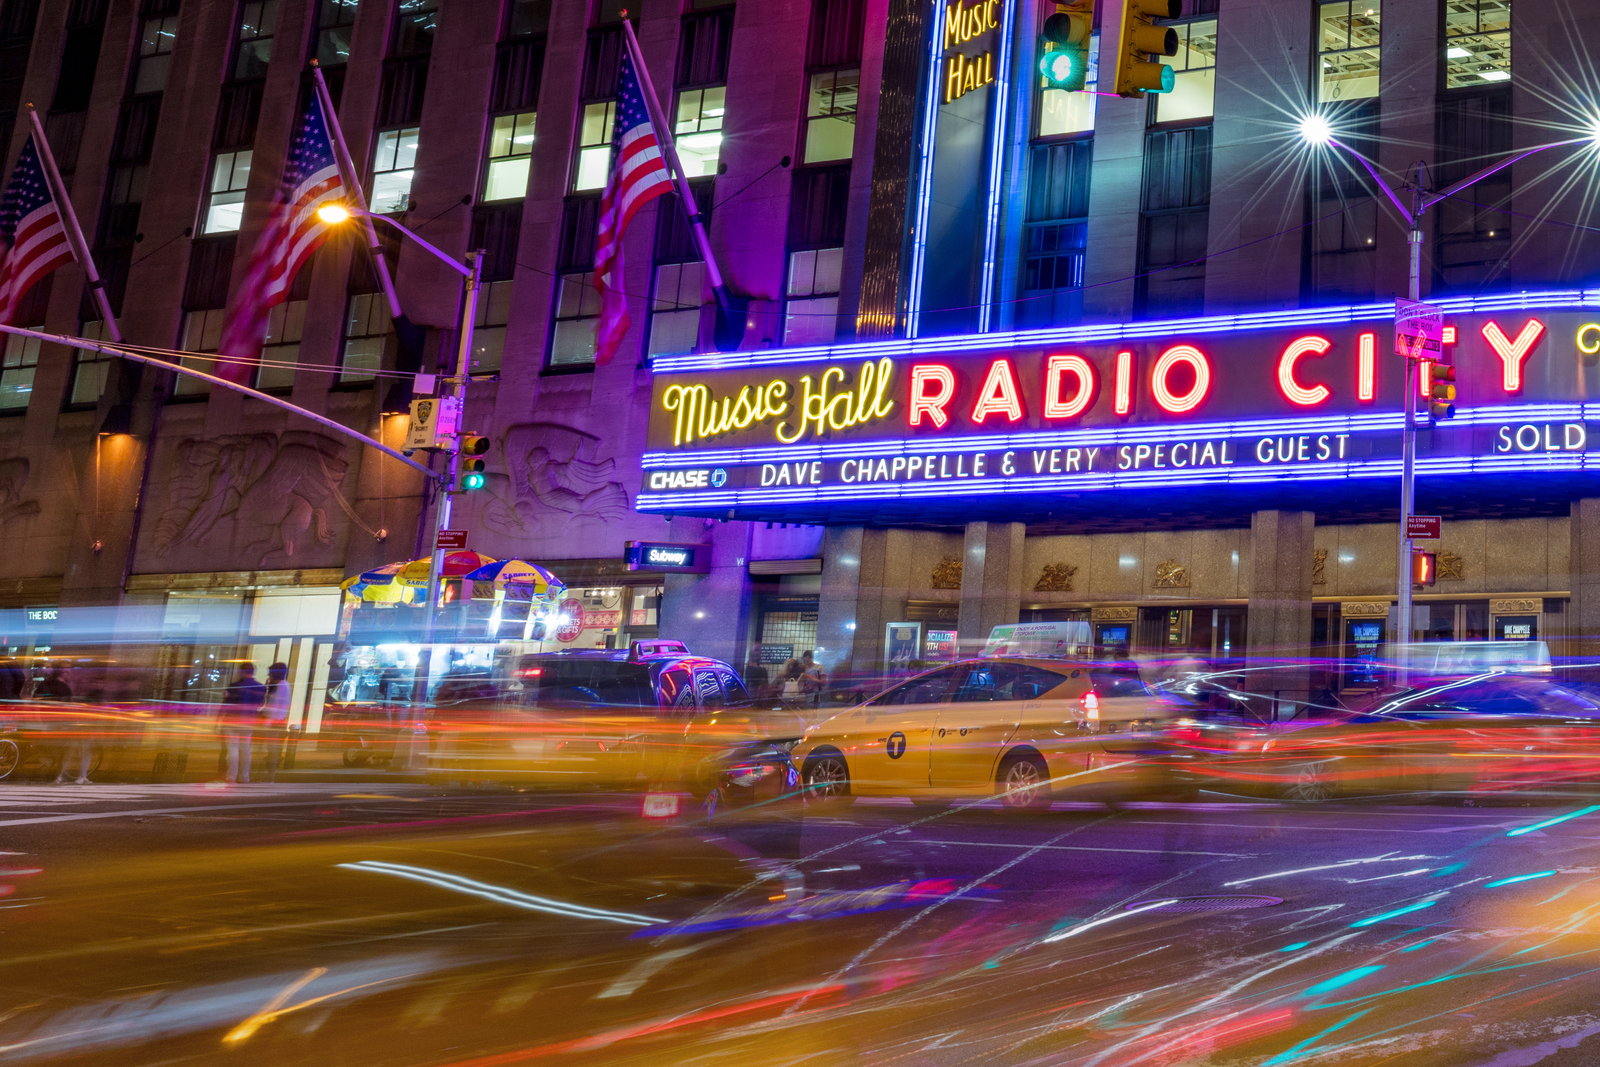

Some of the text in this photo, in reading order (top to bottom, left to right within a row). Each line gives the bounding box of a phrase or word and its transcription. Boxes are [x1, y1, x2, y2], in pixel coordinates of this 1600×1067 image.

[942, 51, 994, 104] HALL
[1406, 319, 1434, 333] THE BOX
[662, 379, 788, 447] Music
[776, 357, 894, 445] Hall
[908, 344, 1212, 428] RADIO
[1498, 423, 1587, 453] SOLD
[650, 434, 1350, 489] CHASE DAVE CHAPPELLE & VERY SPECIAL GUEST
[649, 549, 687, 565] Subway
[502, 572, 536, 580] SABRETT
[28, 611, 42, 620] THE
[562, 626, 579, 634] GIFTS
[938, 642, 950, 651] US!
